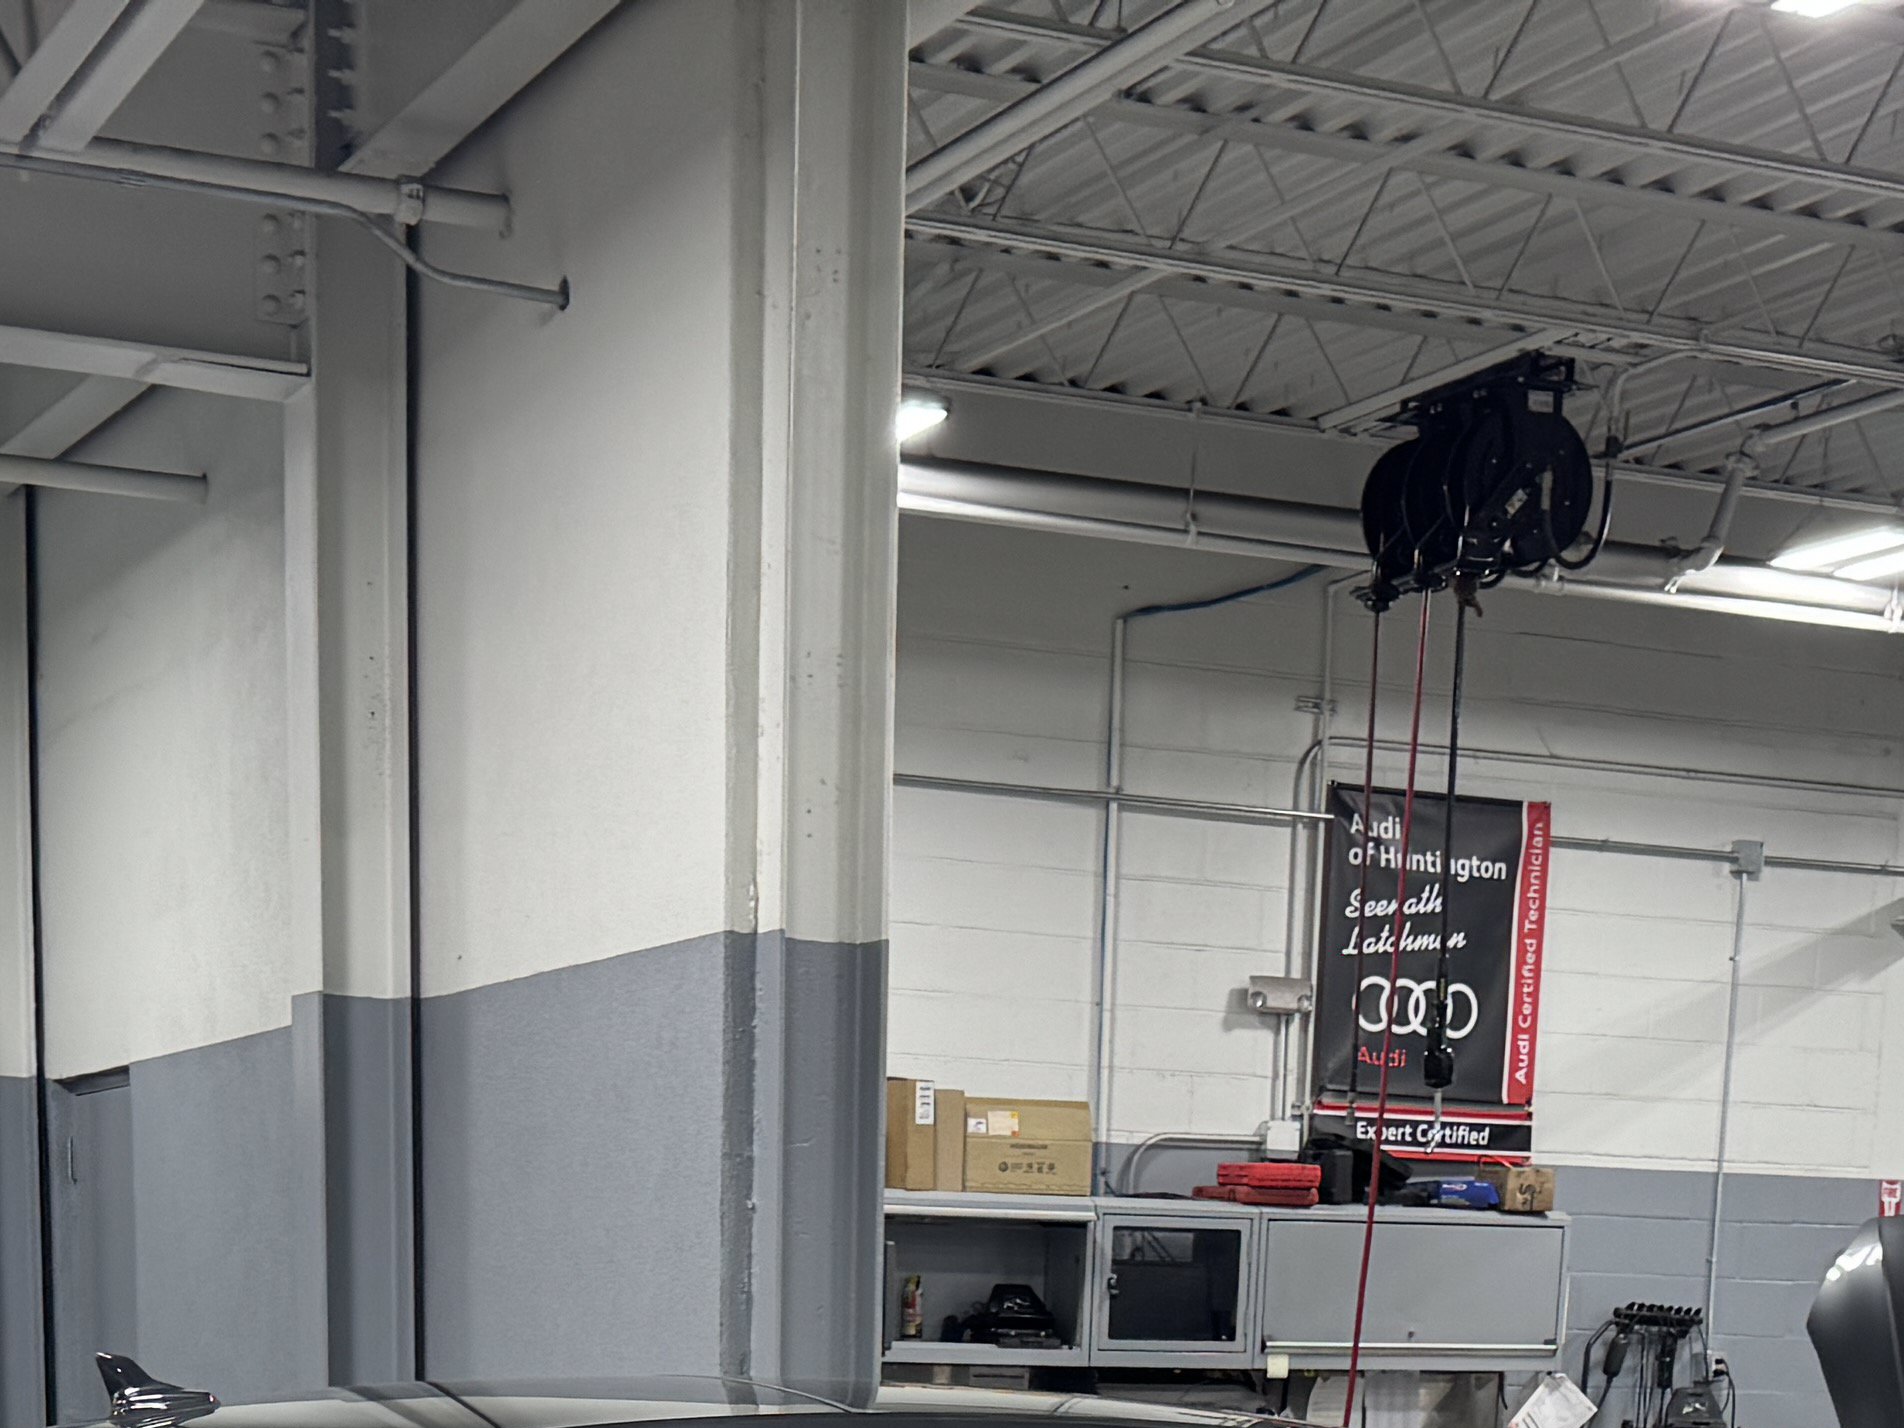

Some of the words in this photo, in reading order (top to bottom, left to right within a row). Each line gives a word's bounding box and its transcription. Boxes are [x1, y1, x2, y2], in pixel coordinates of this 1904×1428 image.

[1350, 813, 1401, 840] Audi
[1348, 842, 1375, 867] of
[1523, 821, 1544, 934] Technician
[1517, 938, 1537, 1029] Certified
[1357, 1047, 1407, 1068] Audi
[1515, 1034, 1530, 1085] Audi
